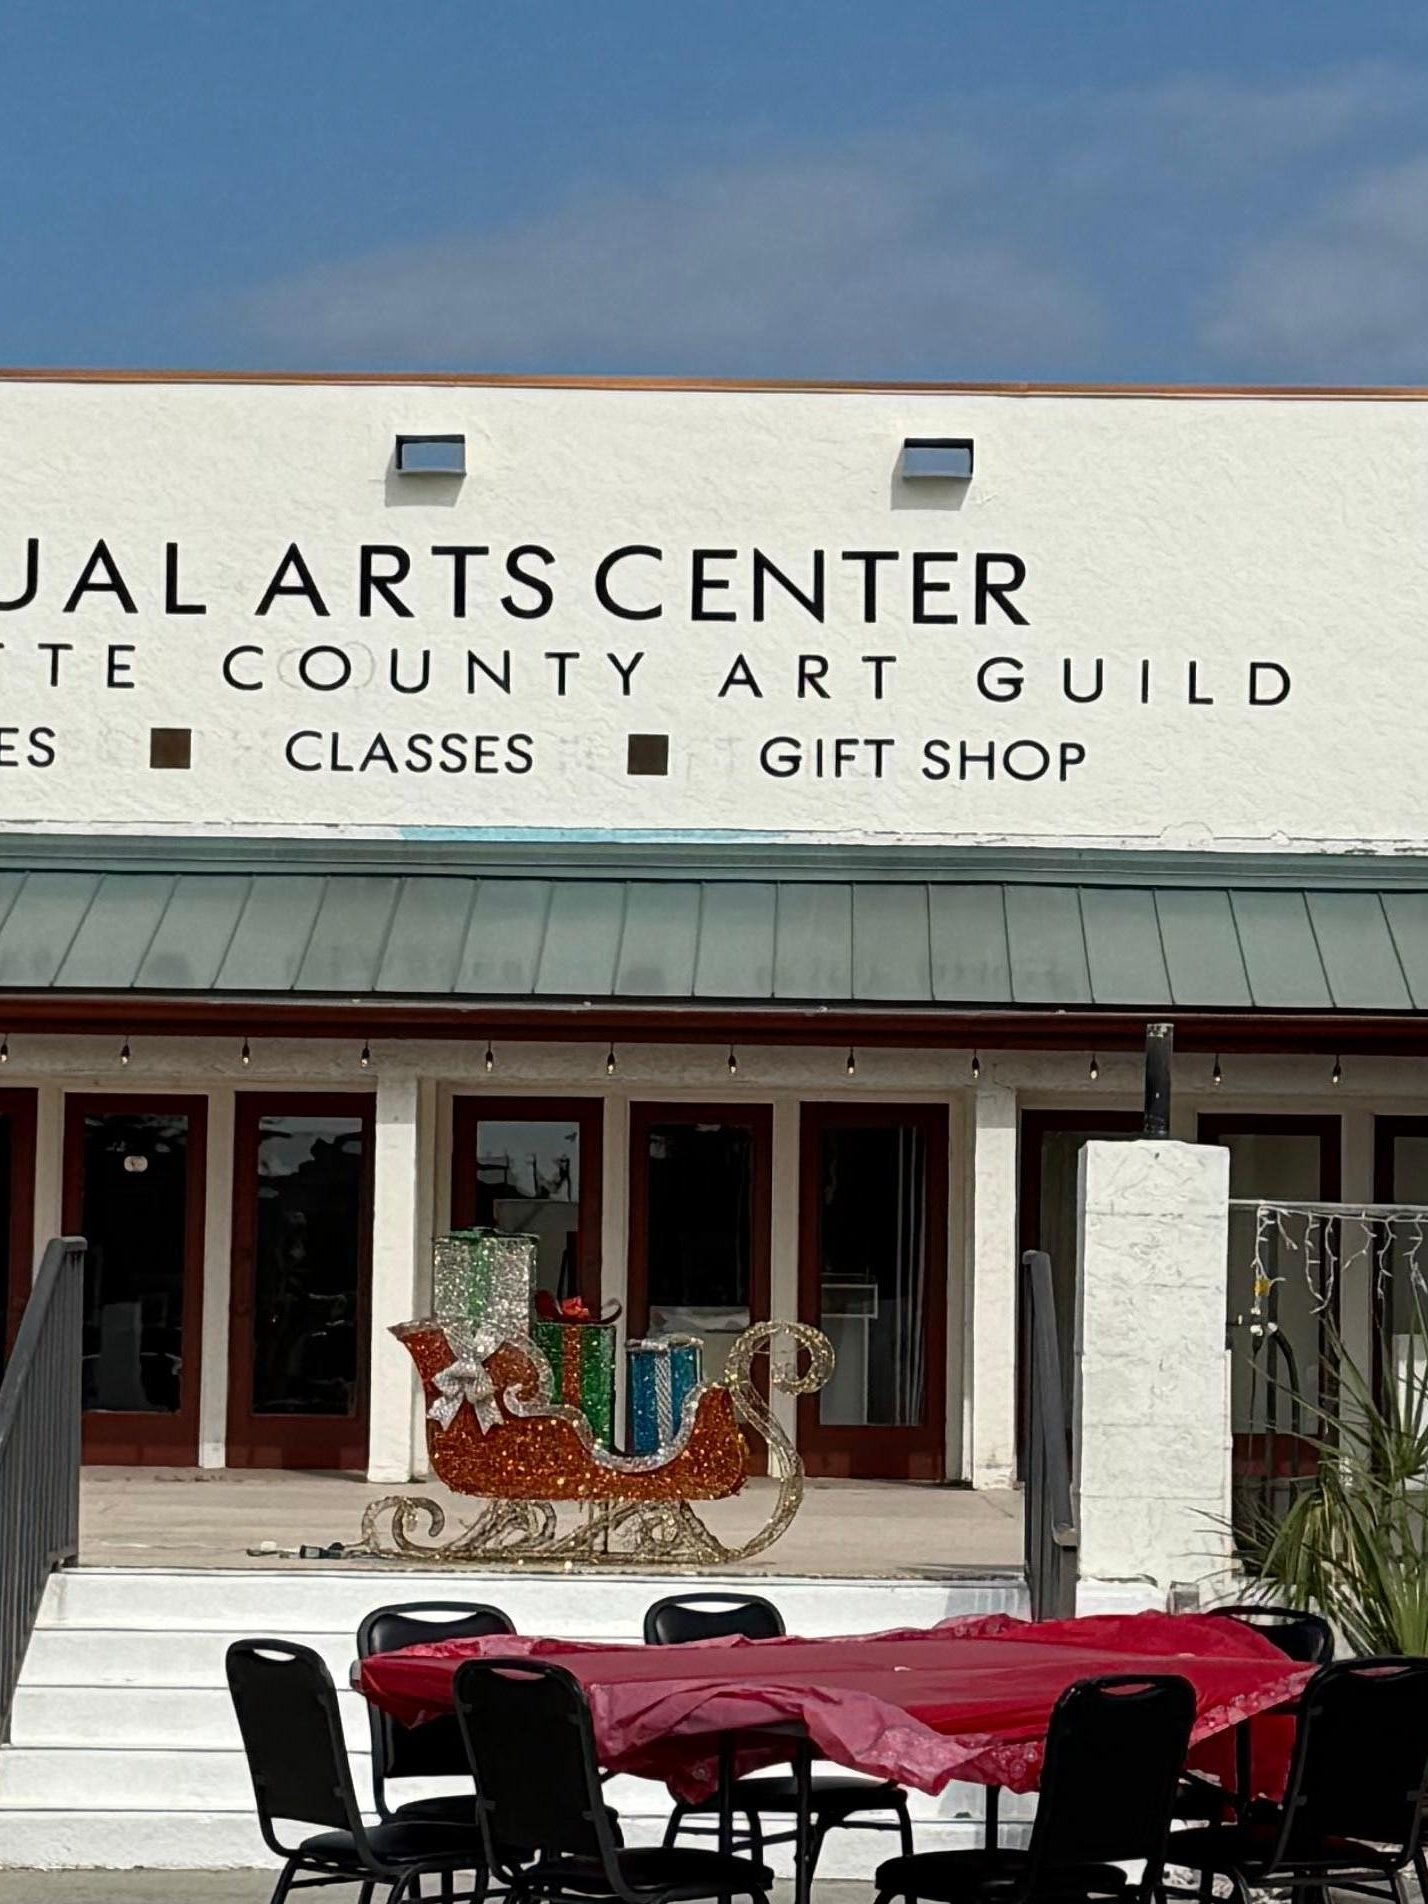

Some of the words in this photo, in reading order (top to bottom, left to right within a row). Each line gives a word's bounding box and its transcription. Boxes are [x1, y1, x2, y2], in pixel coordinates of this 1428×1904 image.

[254, 541, 557, 621] ARTS
[594, 543, 1031, 627] CENTER
[221, 644, 645, 697] COUNTY
[717, 652, 899, 701] ART
[976, 655, 1292, 707] GUILD
[284, 729, 534, 775] CLASSES
[759, 735, 896, 779] GIFT
[921, 738, 1087, 783] SHOP
